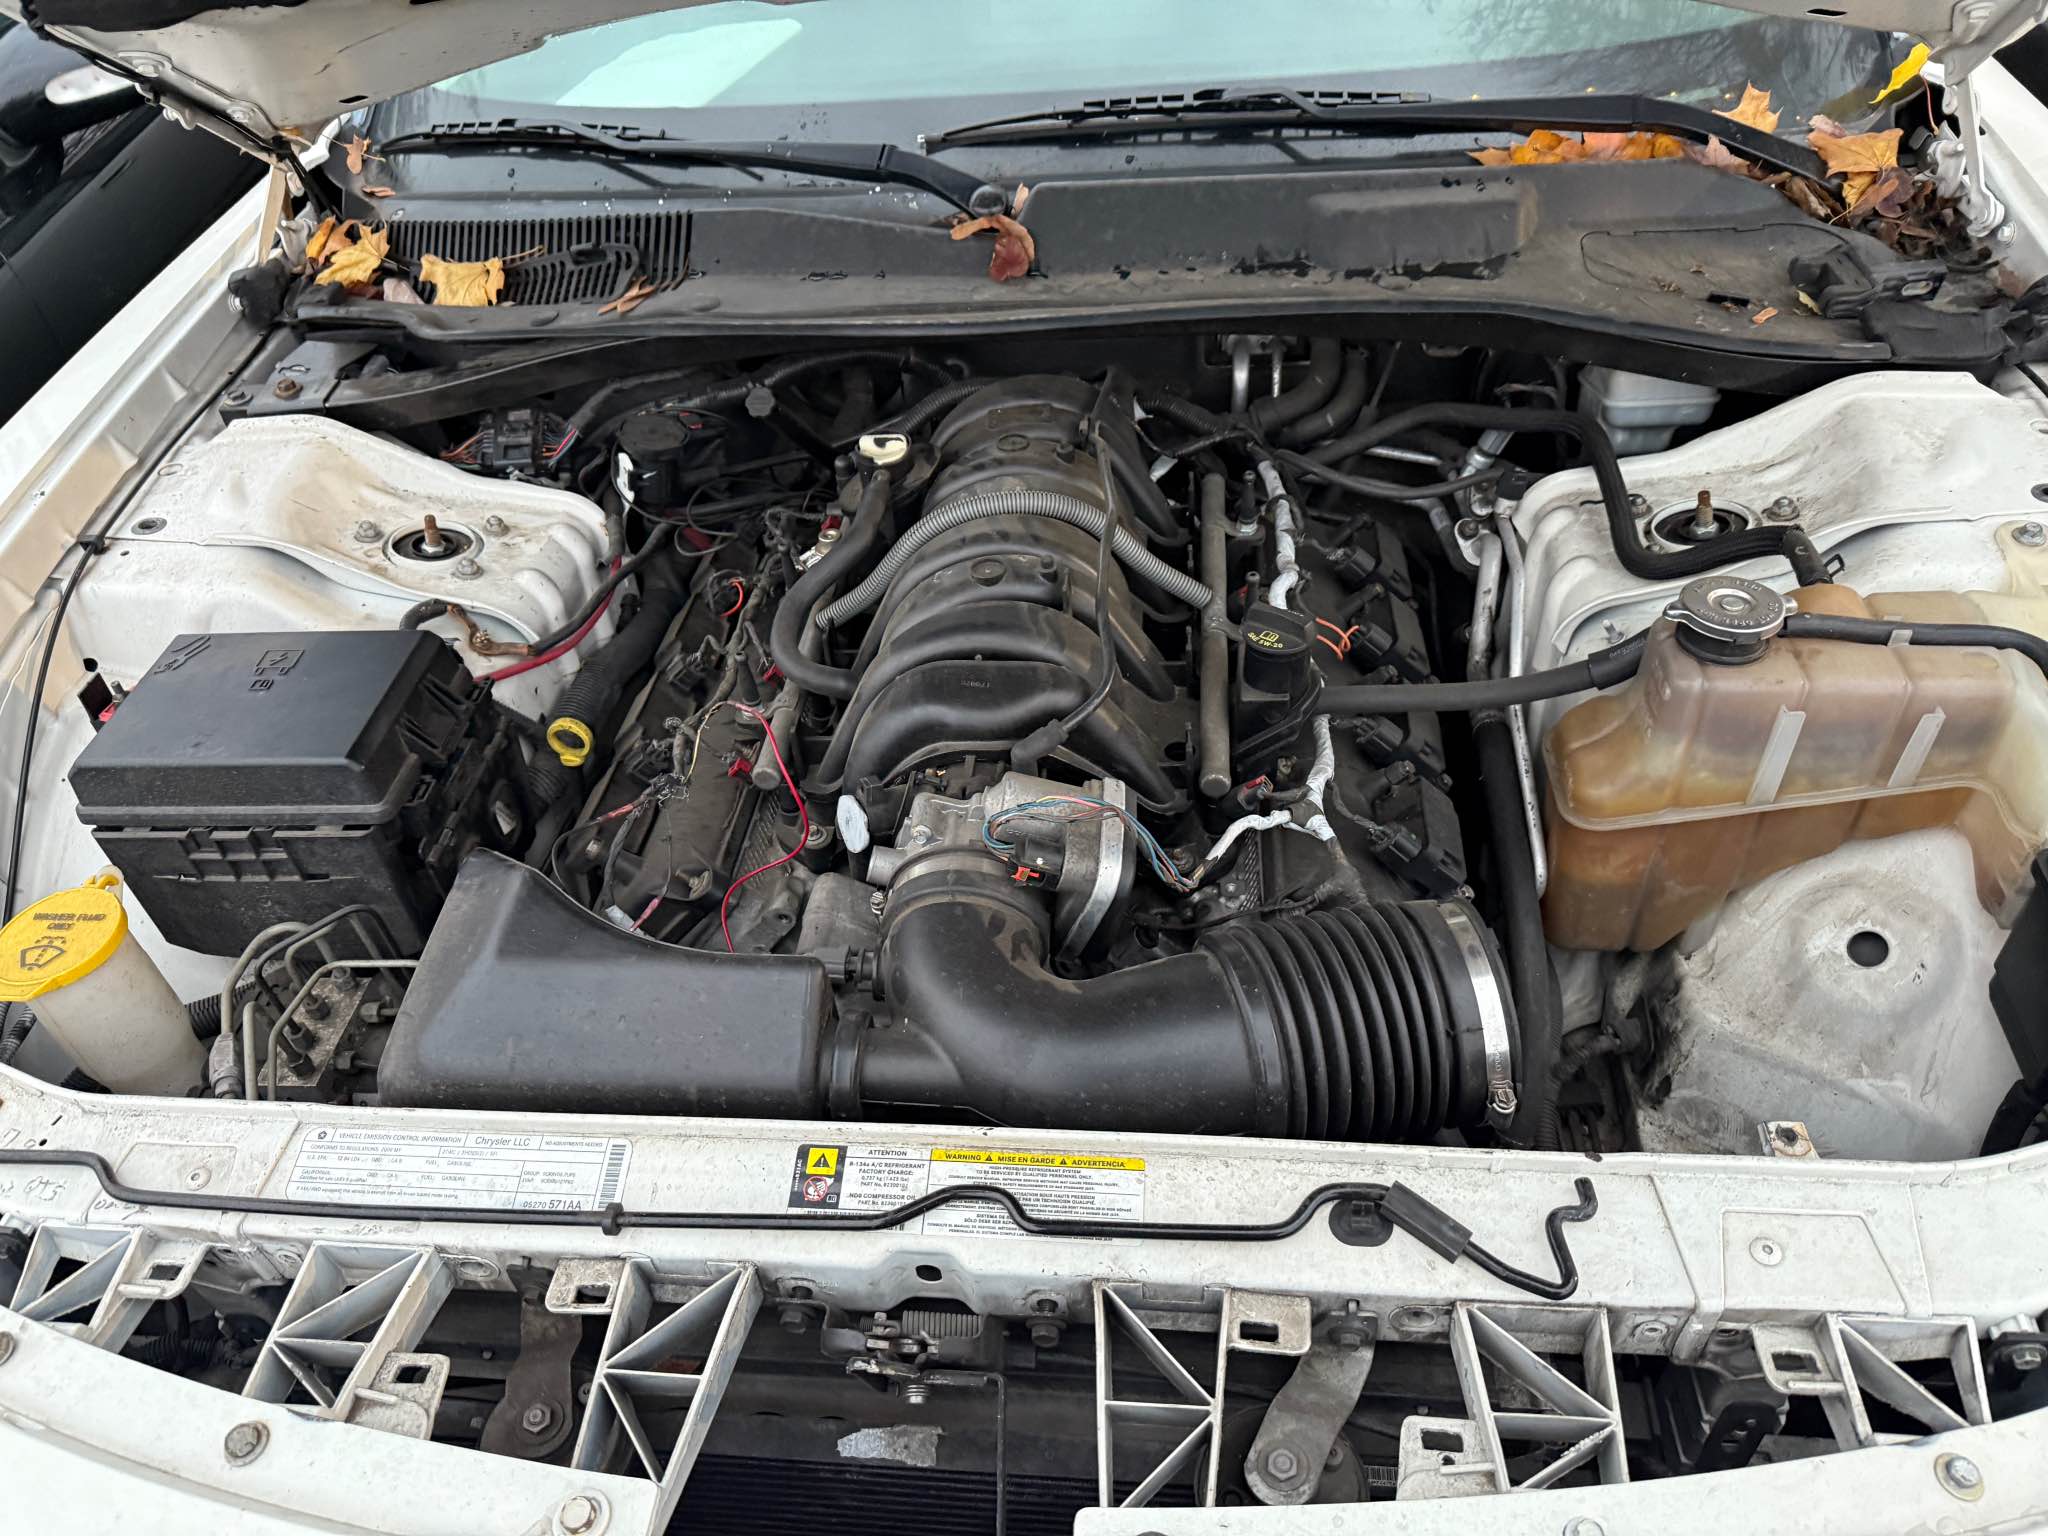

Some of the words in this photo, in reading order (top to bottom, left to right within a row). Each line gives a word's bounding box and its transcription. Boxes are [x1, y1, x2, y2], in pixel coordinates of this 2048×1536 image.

[33, 912, 76, 920] WASHER
[475, 1136, 512, 1148] Chrysler
[513, 1138, 531, 1146] LLC
[946, 1152, 982, 1160] WARNING
[1072, 1160, 1126, 1168] ADVERTENCIA
[548, 1200, 582, 1210] 571AA
